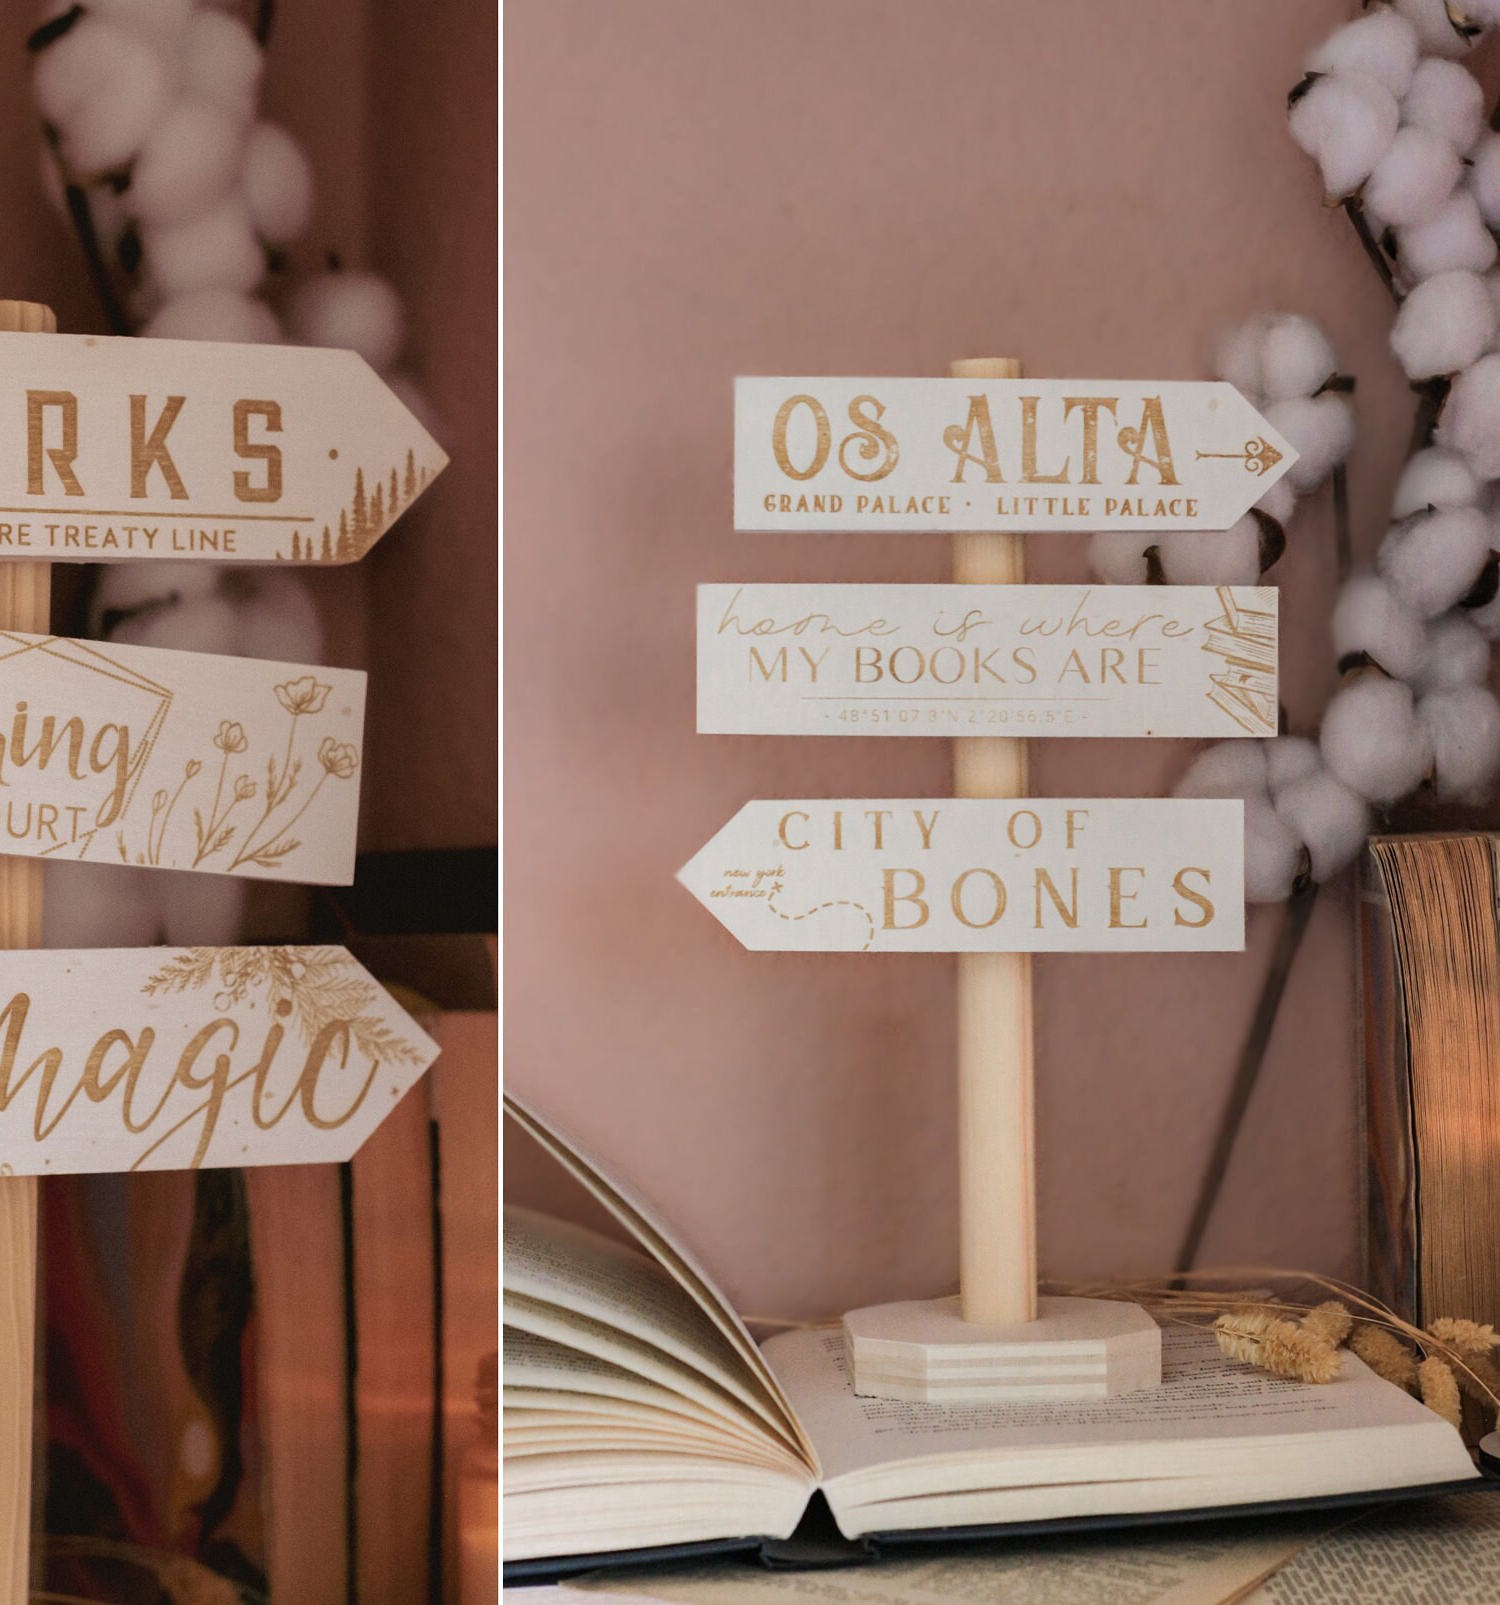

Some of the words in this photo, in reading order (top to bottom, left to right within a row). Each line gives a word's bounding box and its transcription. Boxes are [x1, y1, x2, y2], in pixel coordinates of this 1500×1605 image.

[772, 394, 900, 483] OS
[942, 394, 1183, 487] ALTA
[763, 494, 843, 514] GRAND
[856, 495, 951, 515] PALACE
[996, 496, 1090, 517] LITTLE
[1104, 497, 1199, 518] PALACE
[45, 524, 161, 551] TREATY
[171, 528, 238, 553] LINE
[716, 587, 902, 638] home
[932, 609, 993, 643] is
[1019, 590, 1195, 640] where
[748, 646, 831, 684] MY
[854, 646, 1037, 684] BOOKS
[1057, 646, 1163, 686] ARE
[777, 810, 942, 852] CITY
[1006, 810, 1091, 850] OF
[709, 884, 767, 897] entrance
[723, 869, 750, 878] new
[752, 864, 786, 889] york
[879, 866, 1216, 931] BONES
